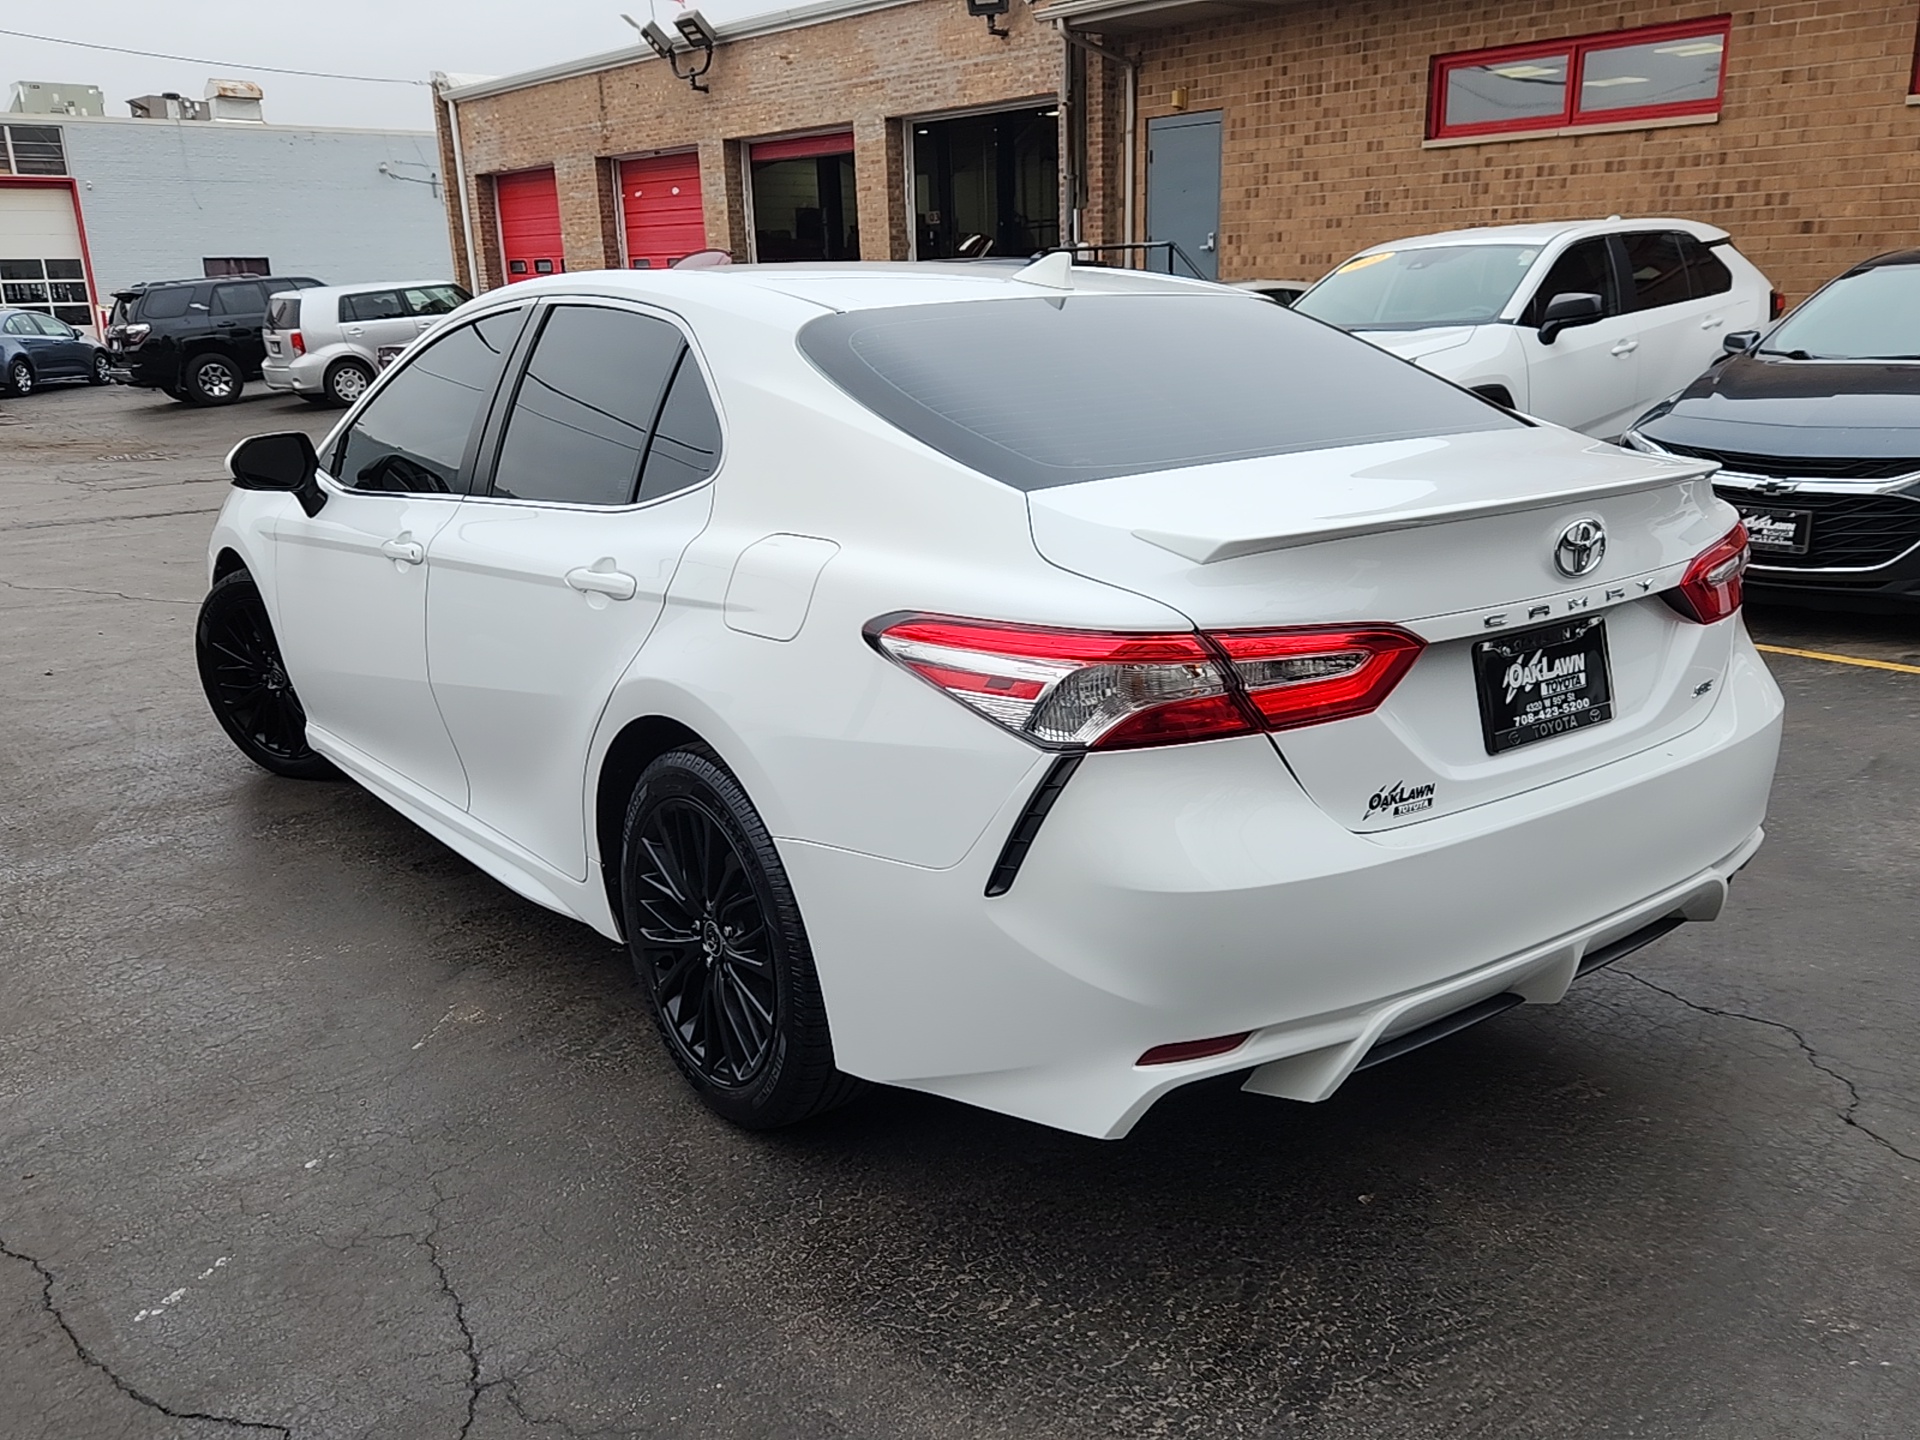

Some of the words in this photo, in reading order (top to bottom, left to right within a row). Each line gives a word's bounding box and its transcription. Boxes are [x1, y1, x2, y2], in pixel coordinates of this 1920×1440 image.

[1483, 577, 1655, 628] CAMRY
[1544, 674, 1583, 695] TOYOTA
[1513, 697, 1590, 727] 708-423-5200
[1532, 714, 1578, 738] TOYOTA
